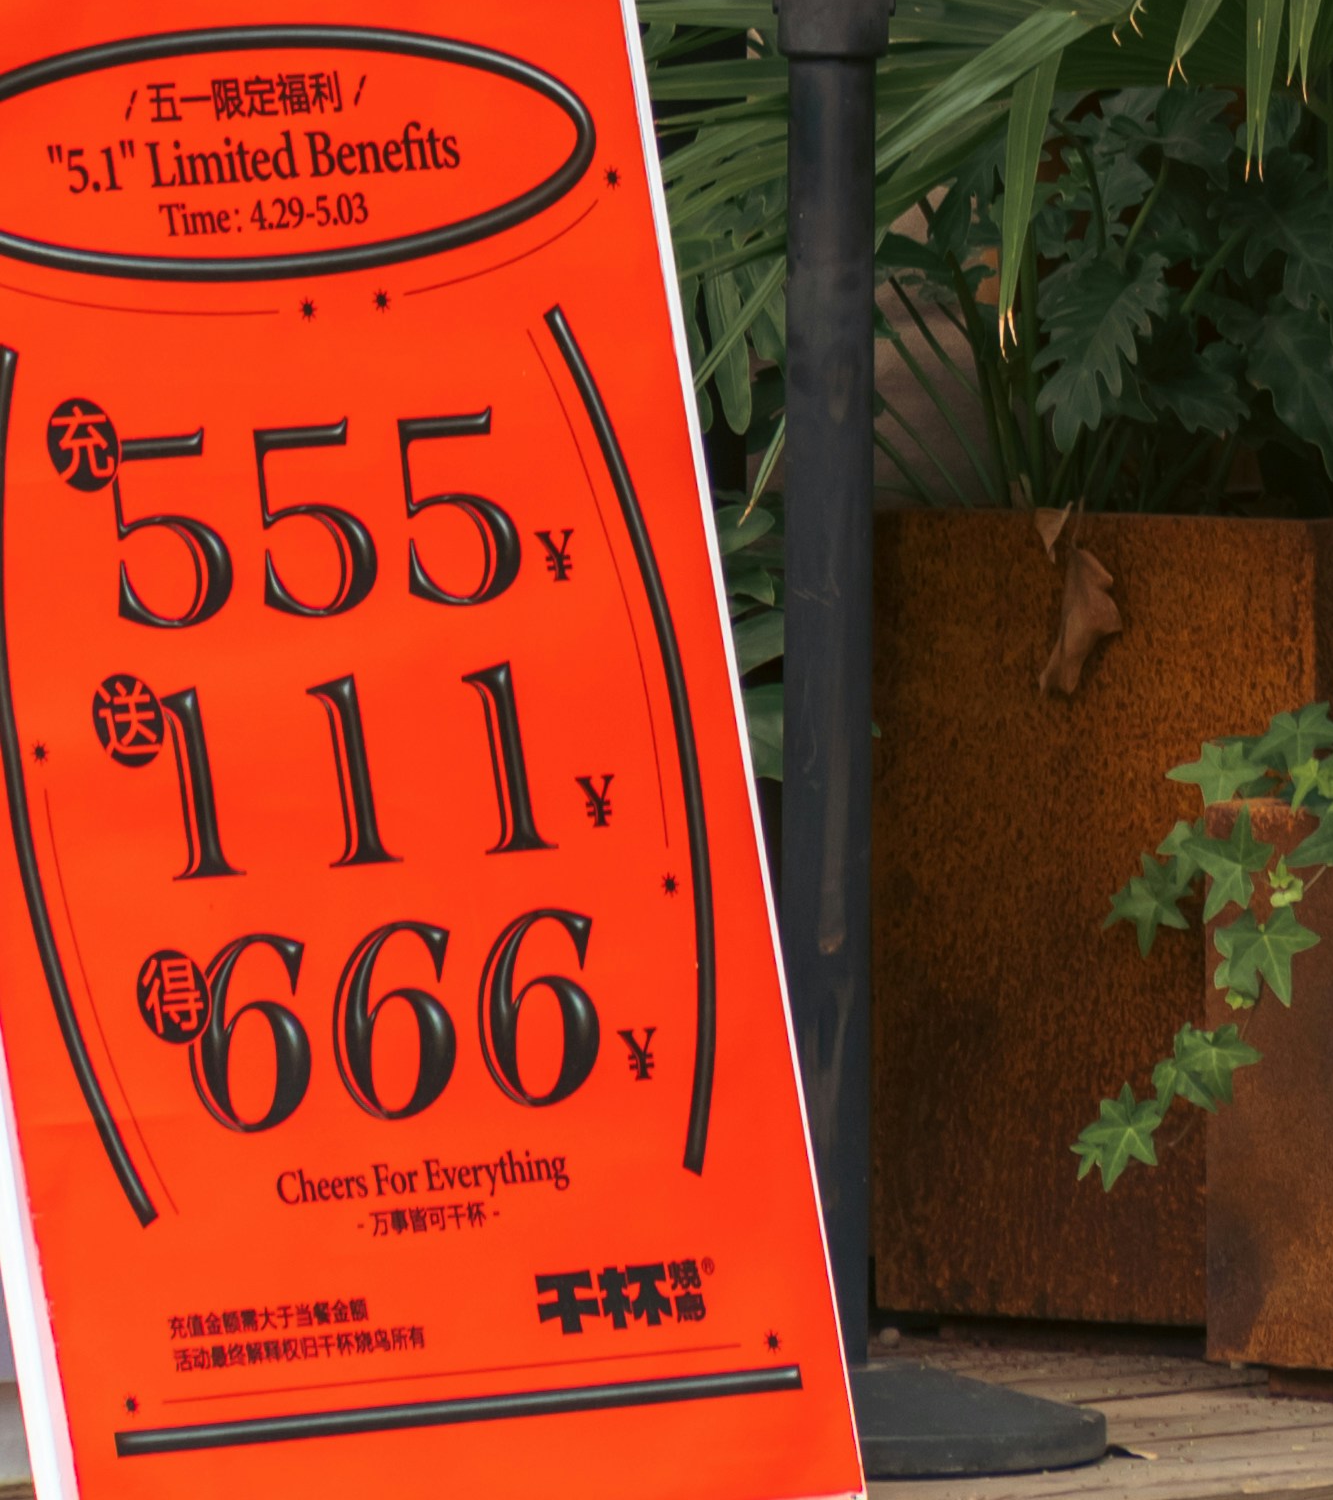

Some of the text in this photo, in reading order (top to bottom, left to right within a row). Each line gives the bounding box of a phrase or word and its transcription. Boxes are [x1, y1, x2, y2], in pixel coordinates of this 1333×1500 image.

[147, 71, 344, 124] 五一限定福利
[47, 122, 461, 194] "5.1" Limited Benefits
[158, 193, 369, 237] Time: 4.29-5.03
[50, 403, 575, 630] 充 555 ¥
[97, 661, 615, 882] 送 111 ¥
[142, 908, 657, 1133] 得 666 ¥
[276, 1149, 571, 1205] Cheers For Everything
